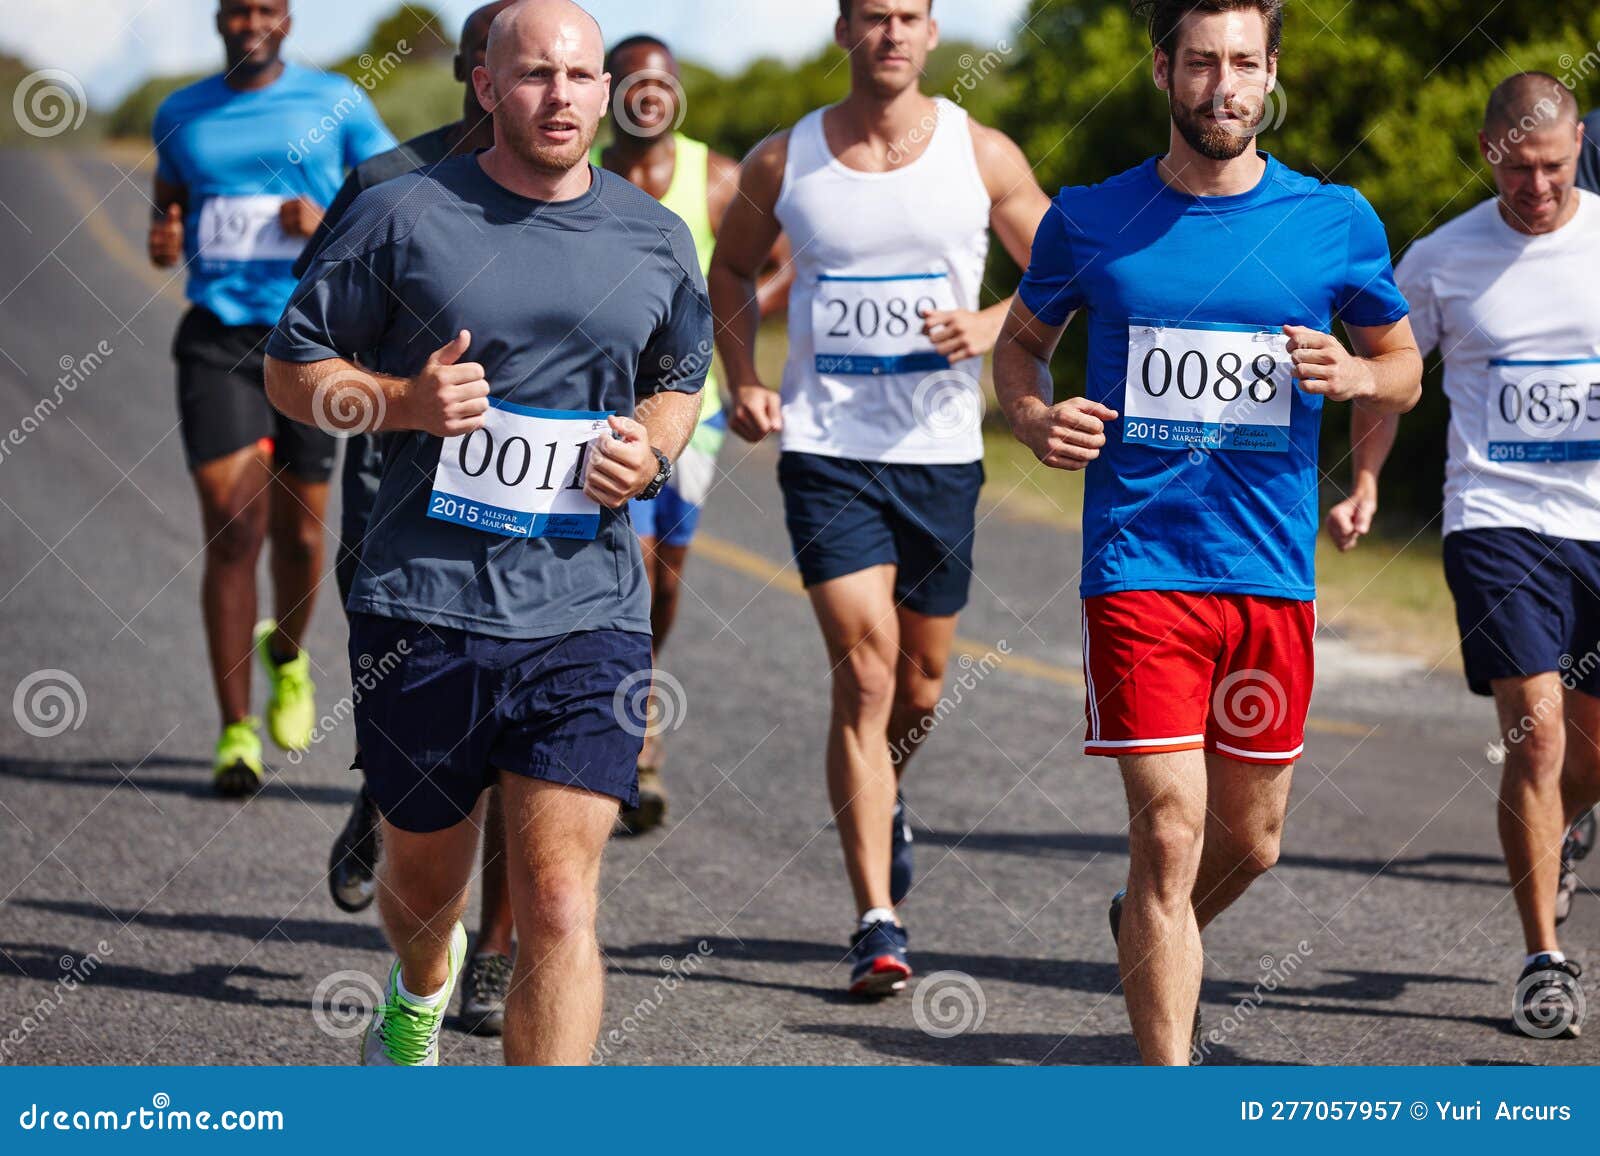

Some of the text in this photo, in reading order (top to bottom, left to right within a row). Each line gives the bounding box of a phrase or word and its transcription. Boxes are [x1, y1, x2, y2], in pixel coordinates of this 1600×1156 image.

[1142, 347, 1277, 404] 0088
[1126, 422, 1169, 440] 2015
[458, 427, 588, 490] 0011
[1490, 444, 1525, 459] 2015
[432, 497, 479, 523] 2015
[483, 509, 518, 524] ALLSTAR
